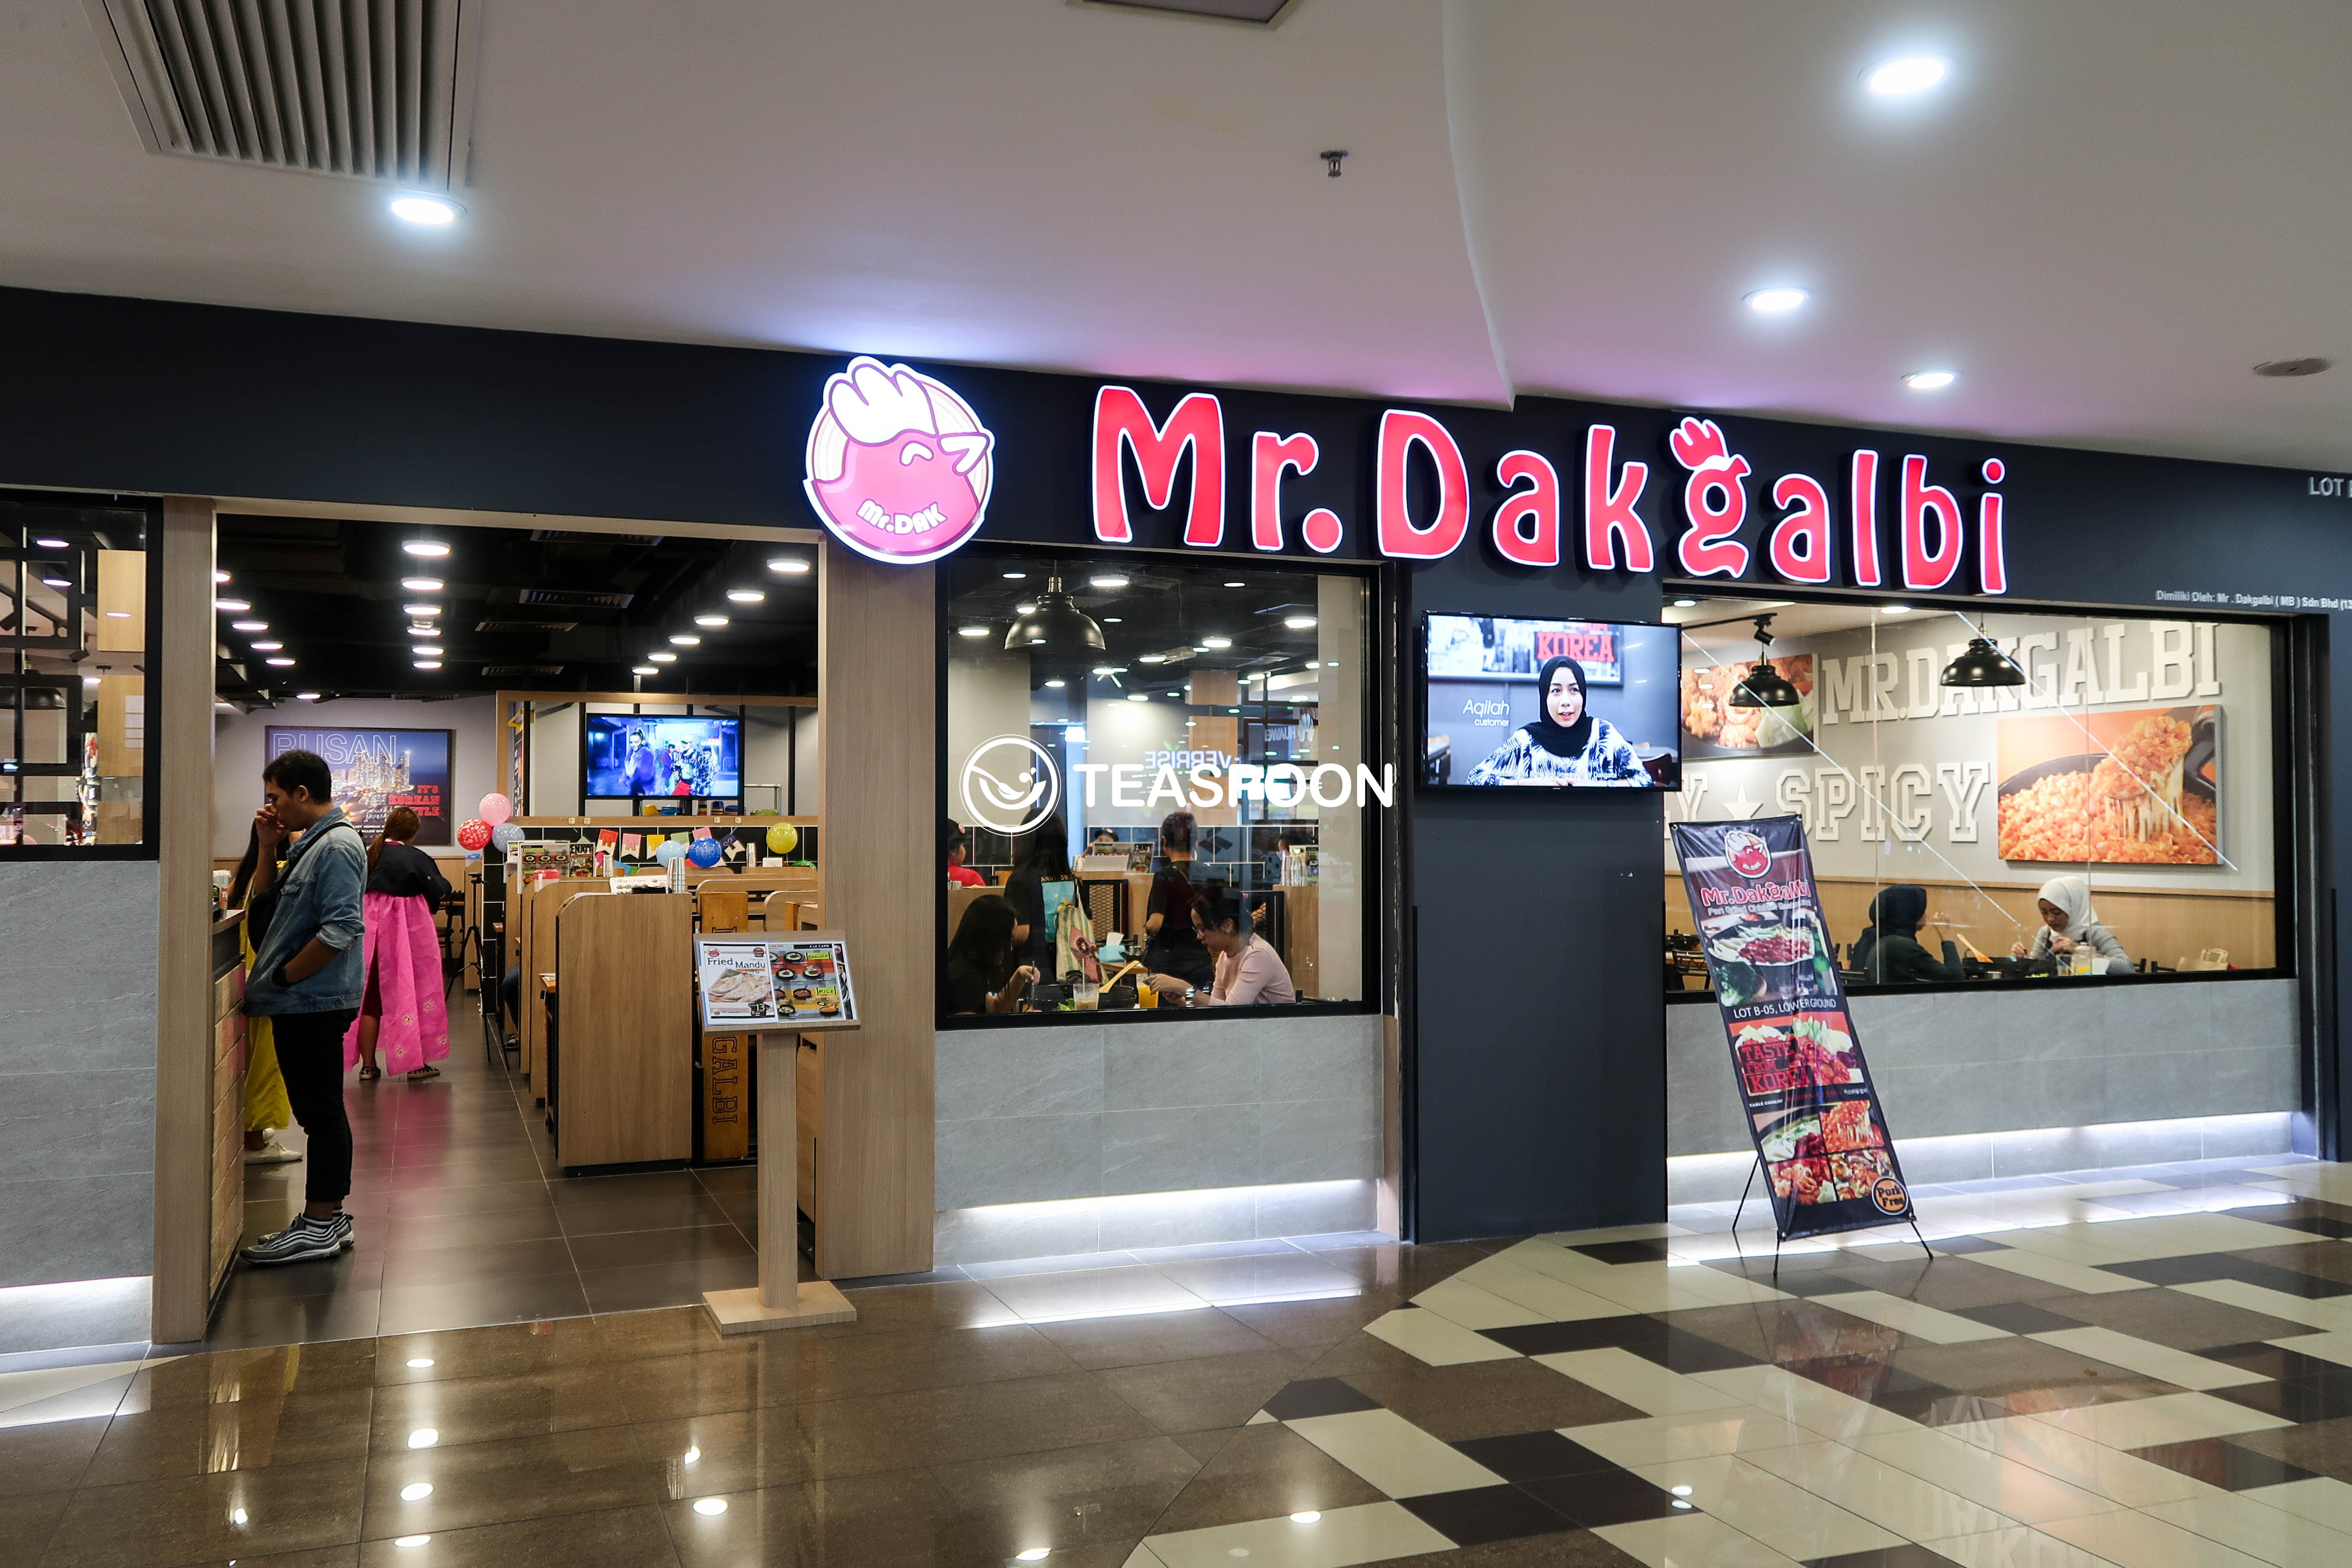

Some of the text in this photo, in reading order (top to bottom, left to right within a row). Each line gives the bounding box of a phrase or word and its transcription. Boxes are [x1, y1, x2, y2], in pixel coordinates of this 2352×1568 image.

[2309, 477, 2344, 497] LOT
[856, 499, 948, 535] Mr.DAK
[2301, 597, 2319, 607] Sdn
[2320, 597, 2339, 608] Bhd
[1537, 631, 1615, 662] KOREA
[1463, 699, 1510, 718] Aqilah
[1474, 718, 1510, 727] customer
[273, 733, 396, 765] BUSAN
[388, 795, 440, 805] KOREAN
[1776, 761, 1990, 842] SPICY
[755, 1003, 765, 1011] 13
[1733, 1007, 1751, 1019] LOT
[1741, 1041, 1795, 1061] TASTE
[1750, 1067, 1811, 1092] KOREA
[1877, 1185, 1901, 1197] Pork
